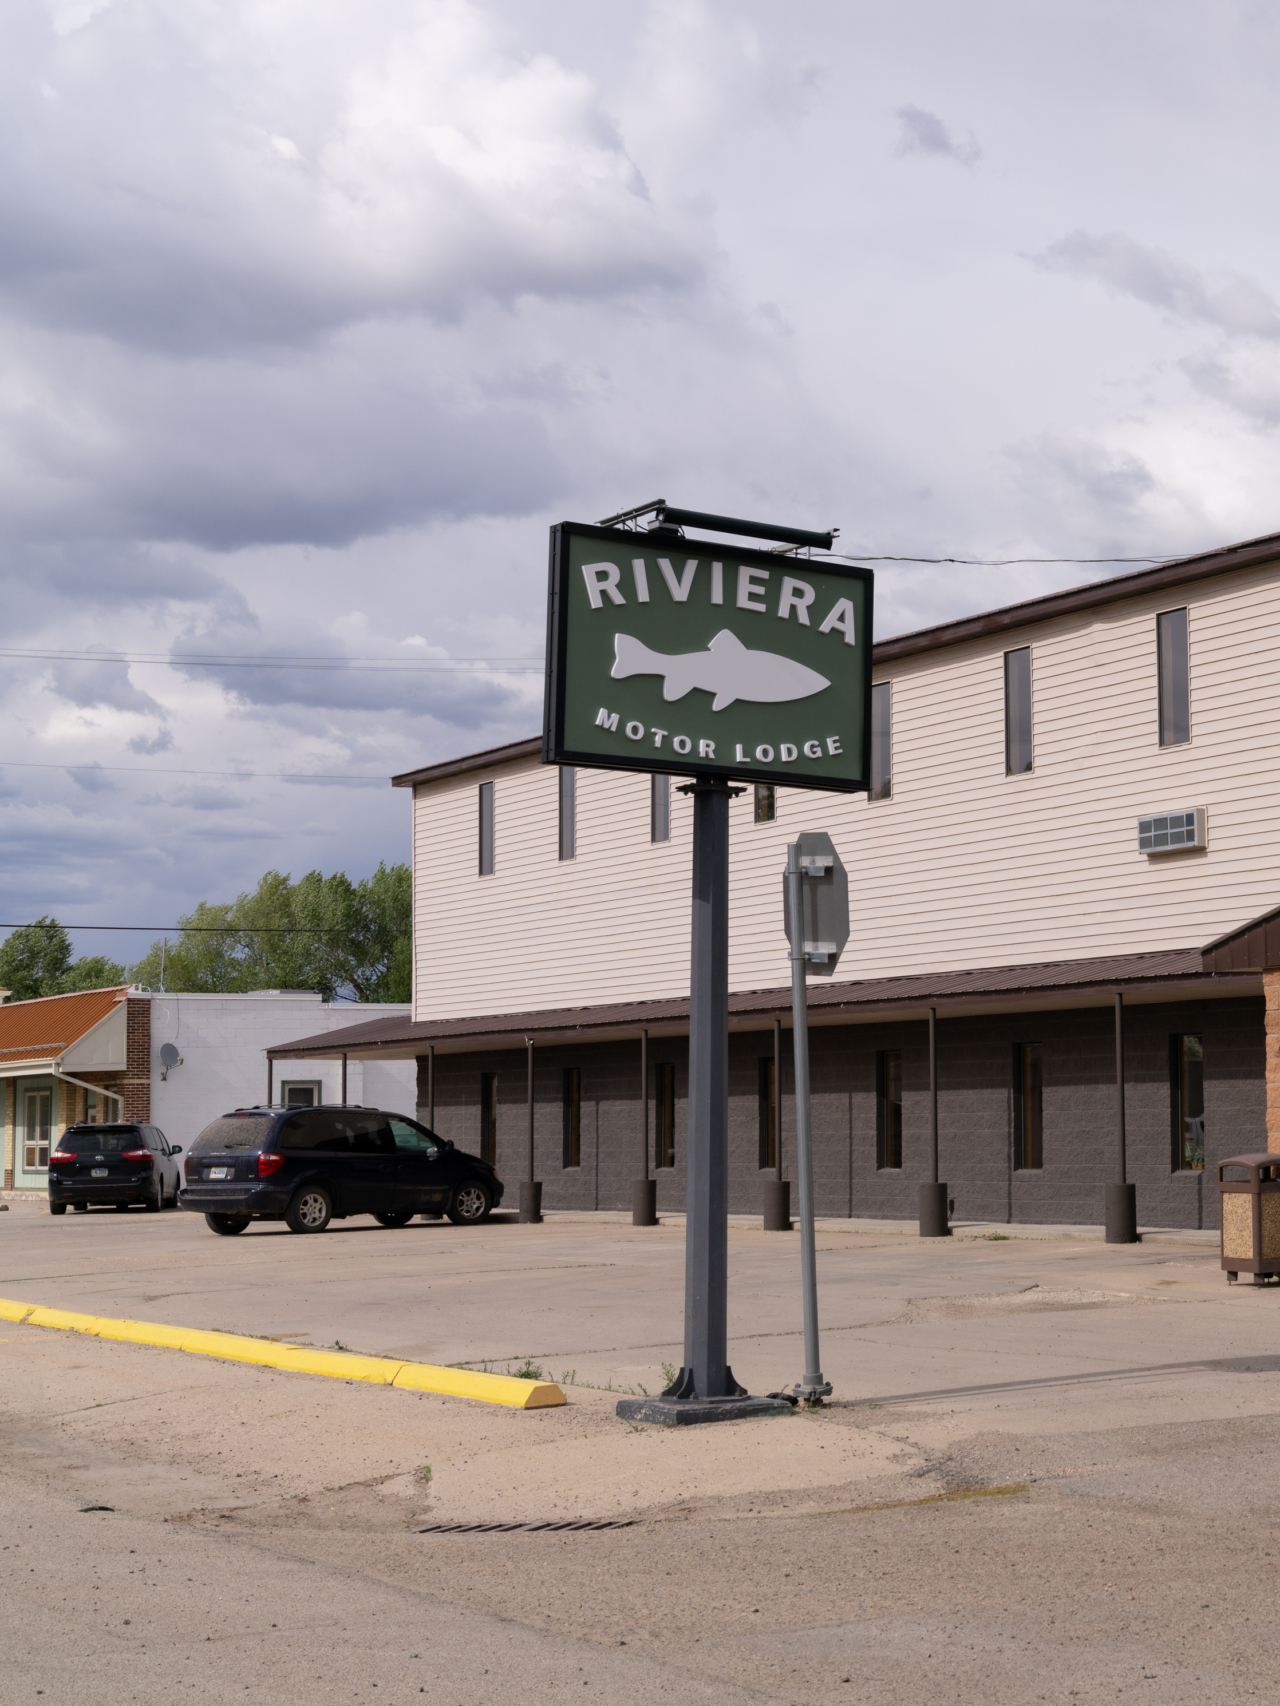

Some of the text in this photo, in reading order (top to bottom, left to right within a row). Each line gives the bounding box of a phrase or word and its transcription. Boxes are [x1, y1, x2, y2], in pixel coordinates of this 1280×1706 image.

[581, 558, 856, 646] RIVIERA
[595, 707, 843, 763] MOTOR LODGE
